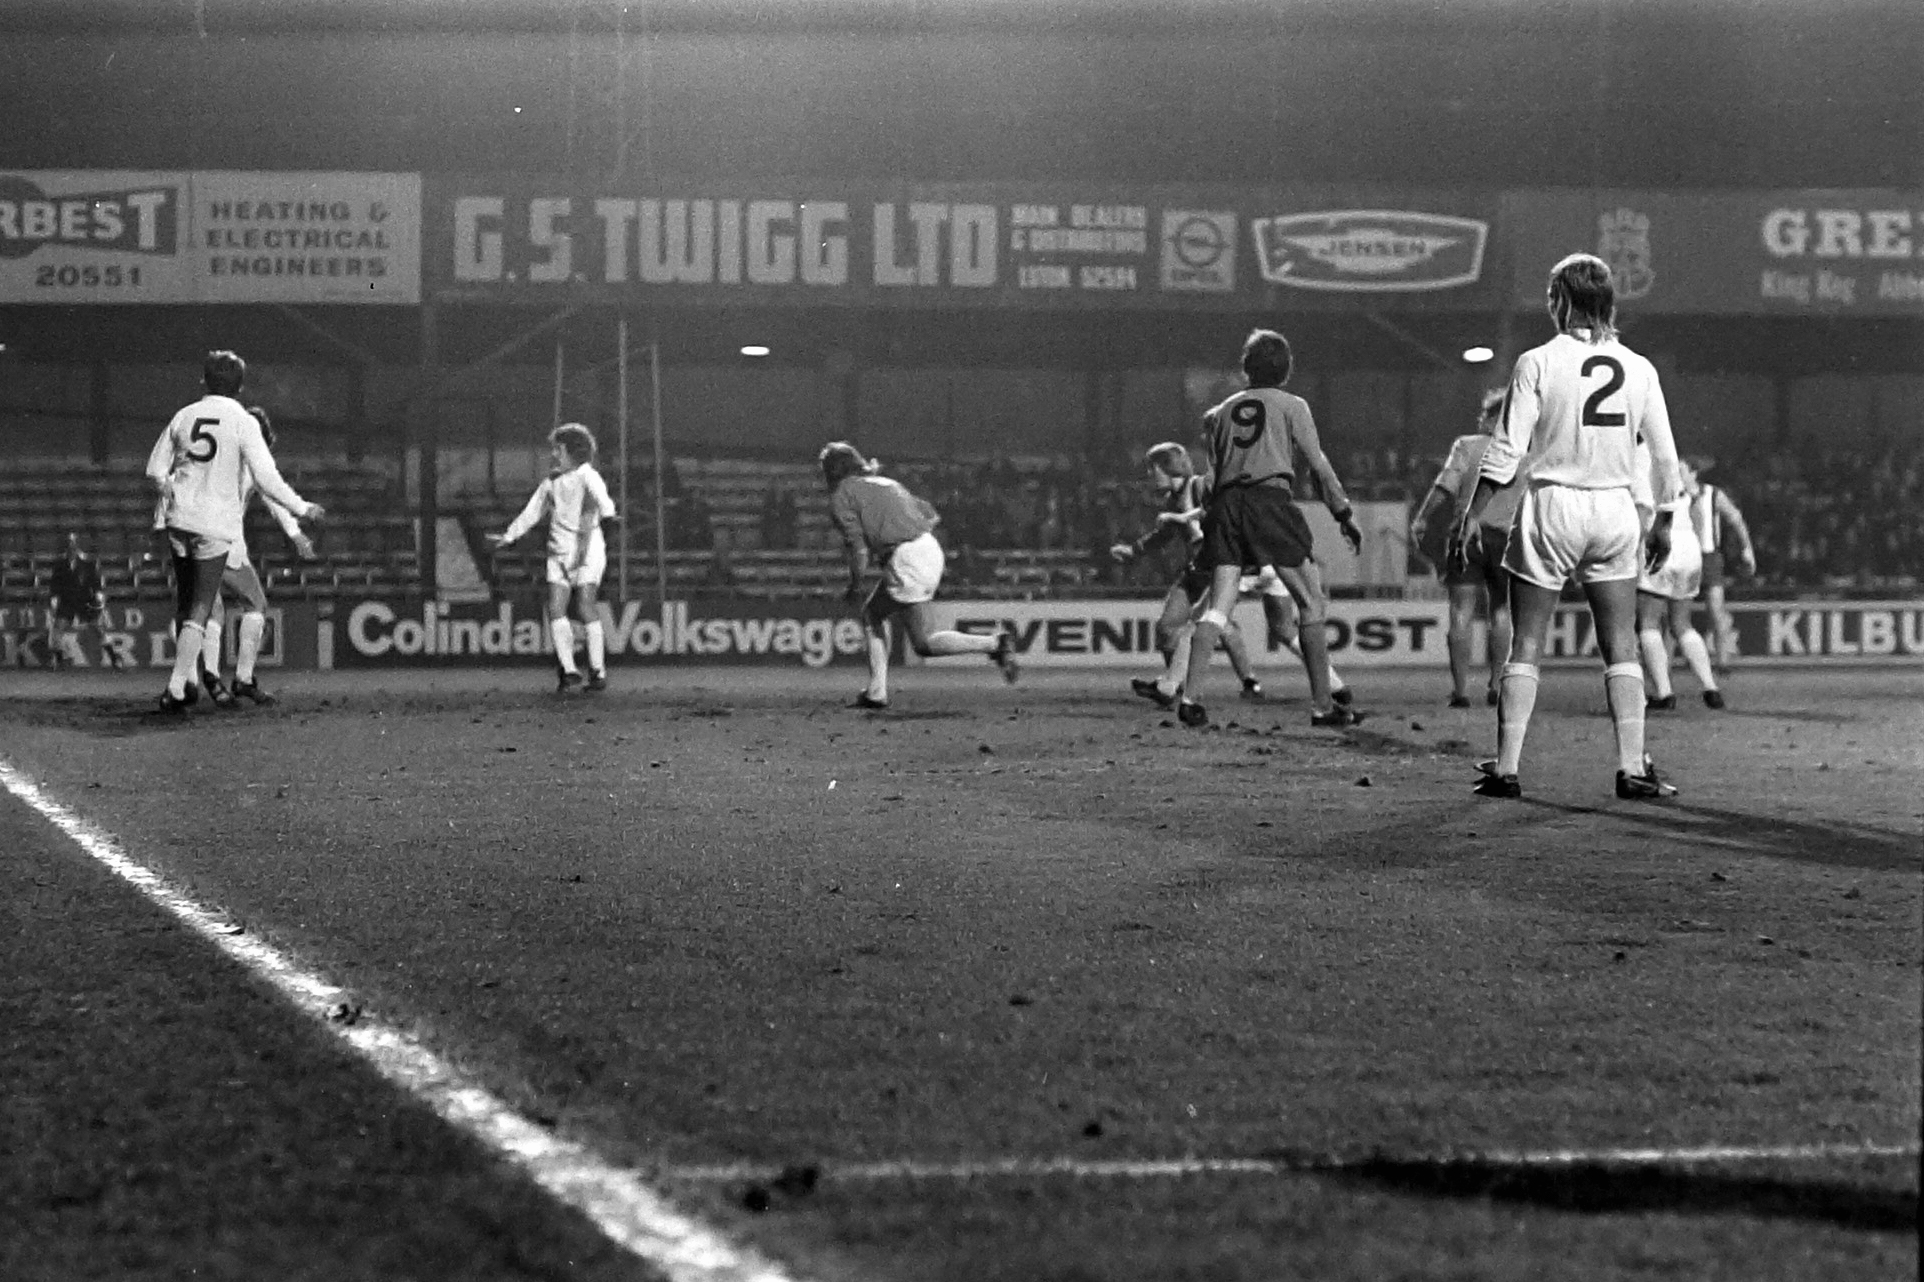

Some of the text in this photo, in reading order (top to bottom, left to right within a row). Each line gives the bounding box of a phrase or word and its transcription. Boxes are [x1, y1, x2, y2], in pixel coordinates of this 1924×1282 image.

[210, 201, 351, 222] HEATING
[1762, 208, 1924, 258] GRE
[205, 228, 390, 250] ELECTRICAL
[596, 198, 849, 285] TWIGG
[873, 202, 998, 287] LTD
[36, 264, 142, 287] 20551
[210, 256, 388, 277] ENGINEERS
[1580, 354, 1627, 427] 2
[186, 417, 221, 463] 5
[1231, 398, 1267, 449] 9
[596, 600, 888, 668] Volkswage
[956, 618, 1228, 654] EVENI
